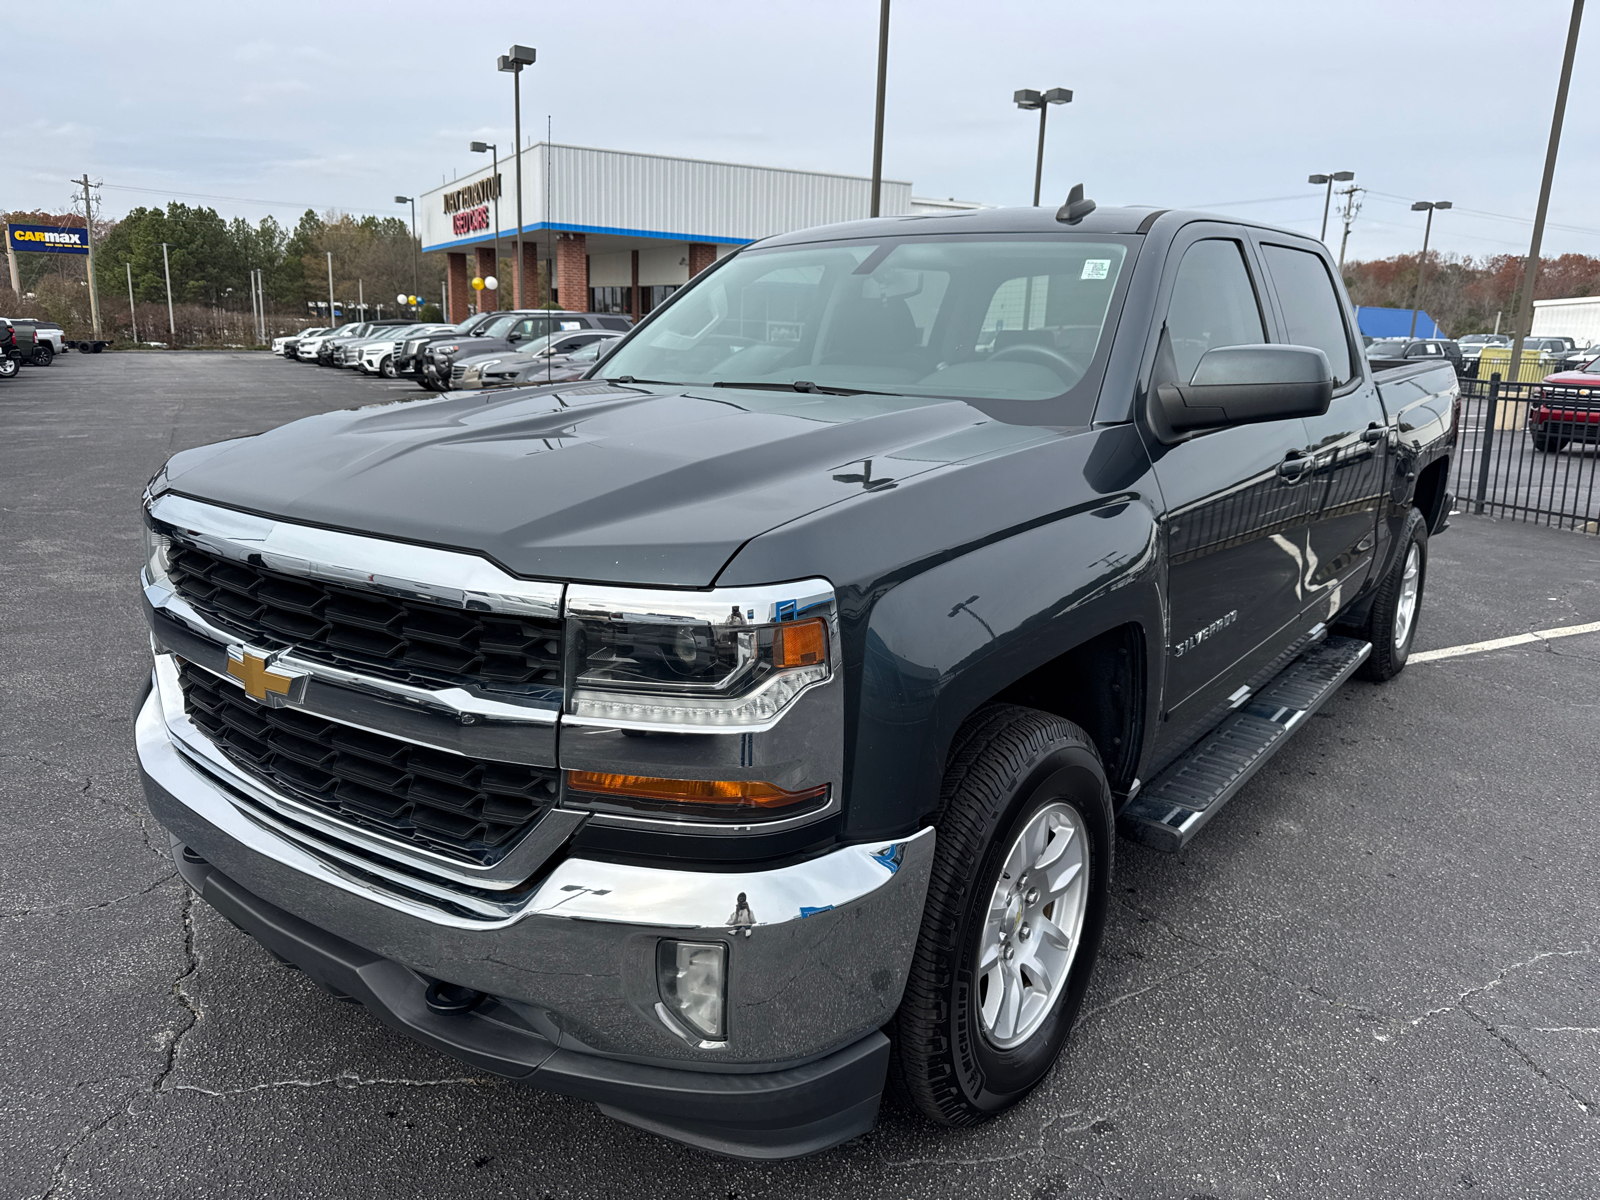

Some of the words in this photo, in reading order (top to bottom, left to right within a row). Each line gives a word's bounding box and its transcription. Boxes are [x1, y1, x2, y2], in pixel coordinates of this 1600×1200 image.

[14, 230, 81, 244] CARmax
[453, 212, 469, 235] USED
[469, 205, 489, 231] CARS
[1174, 610, 1237, 657] SILVERADO
[958, 987, 974, 1074] MICHELIN
